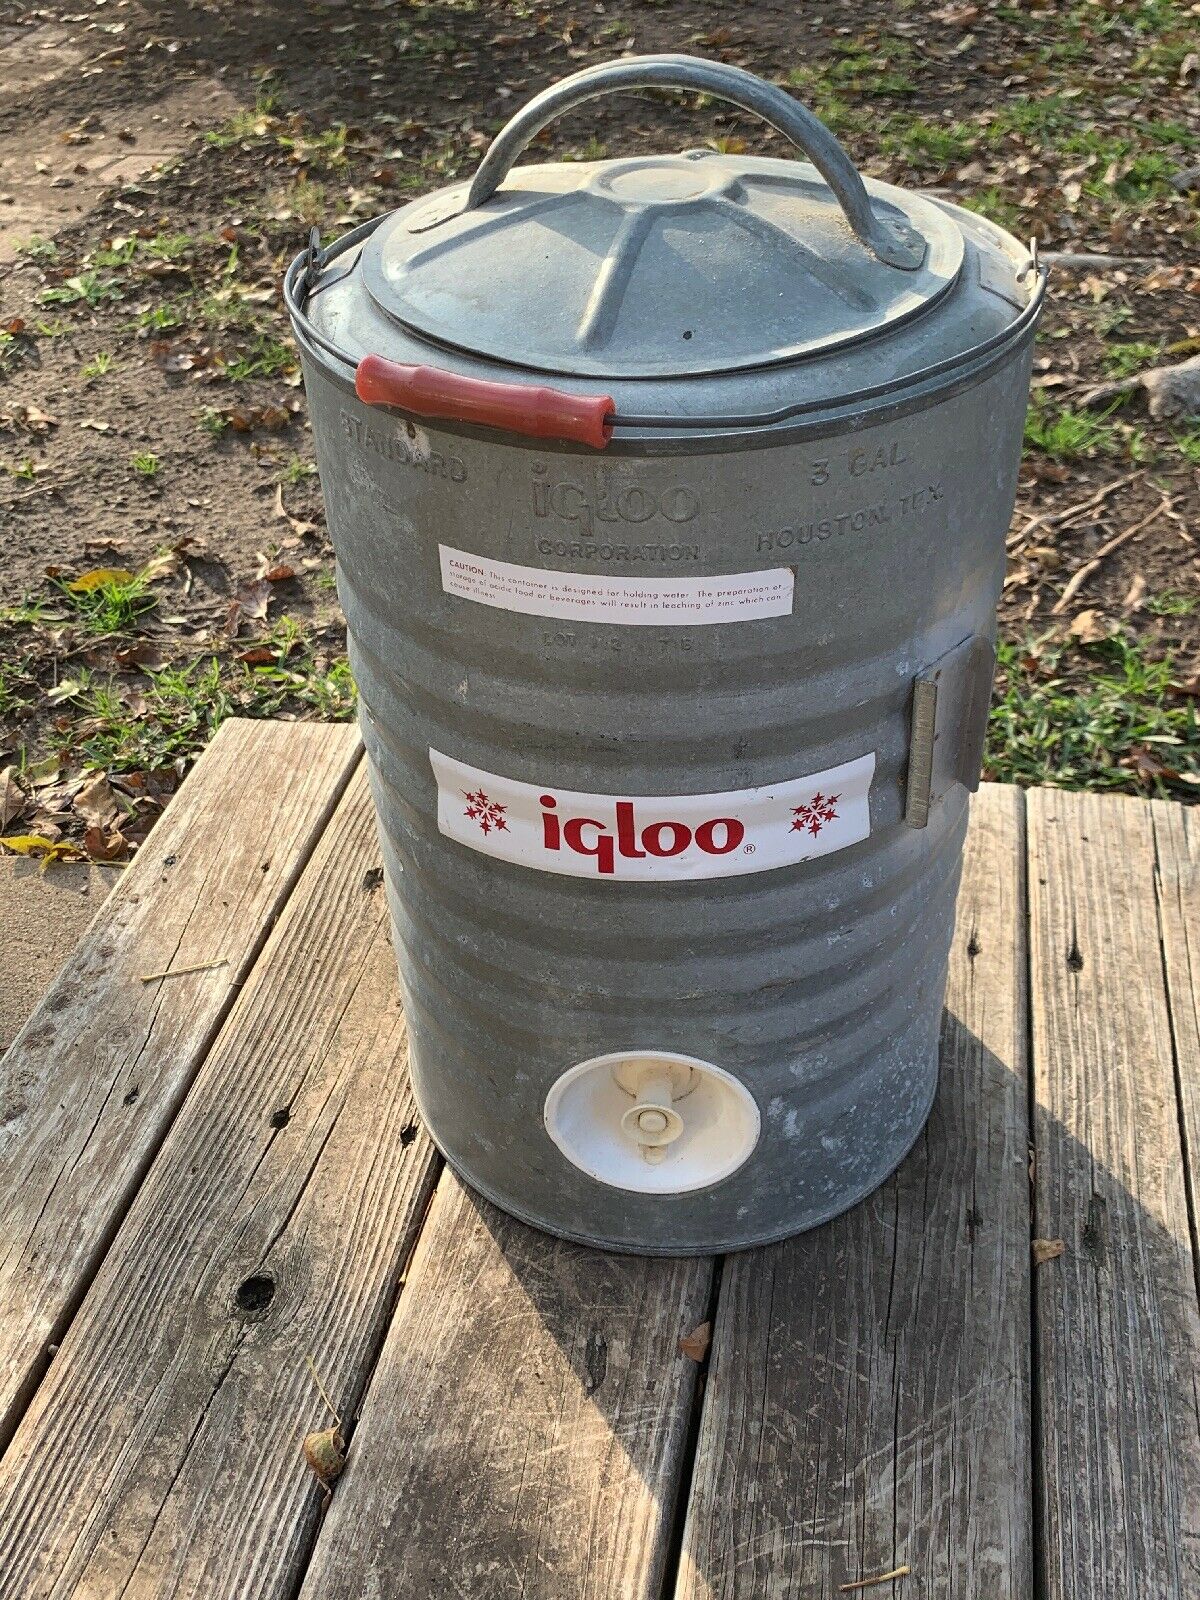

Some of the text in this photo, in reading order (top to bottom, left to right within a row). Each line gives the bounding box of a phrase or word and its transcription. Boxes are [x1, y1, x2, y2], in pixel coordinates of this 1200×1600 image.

[811, 442, 907, 486] 3 GAL
[537, 538, 700, 561] CORPORATION
[449, 571, 476, 584] storage
[489, 583, 512, 593] acidic
[515, 587, 534, 597] food
[549, 594, 596, 605] beverages
[600, 599, 617, 607] will
[620, 601, 647, 609] result
[662, 602, 701, 610] leaching
[705, 600, 714, 608] of
[739, 597, 764, 605] which
[450, 581, 470, 592] cause
[490, 571, 505, 582] This
[508, 578, 547, 589] container
[562, 585, 603, 596] designed
[623, 590, 659, 600] holding
[717, 586, 769, 598] preparation
[539, 794, 745, 874] igloo
